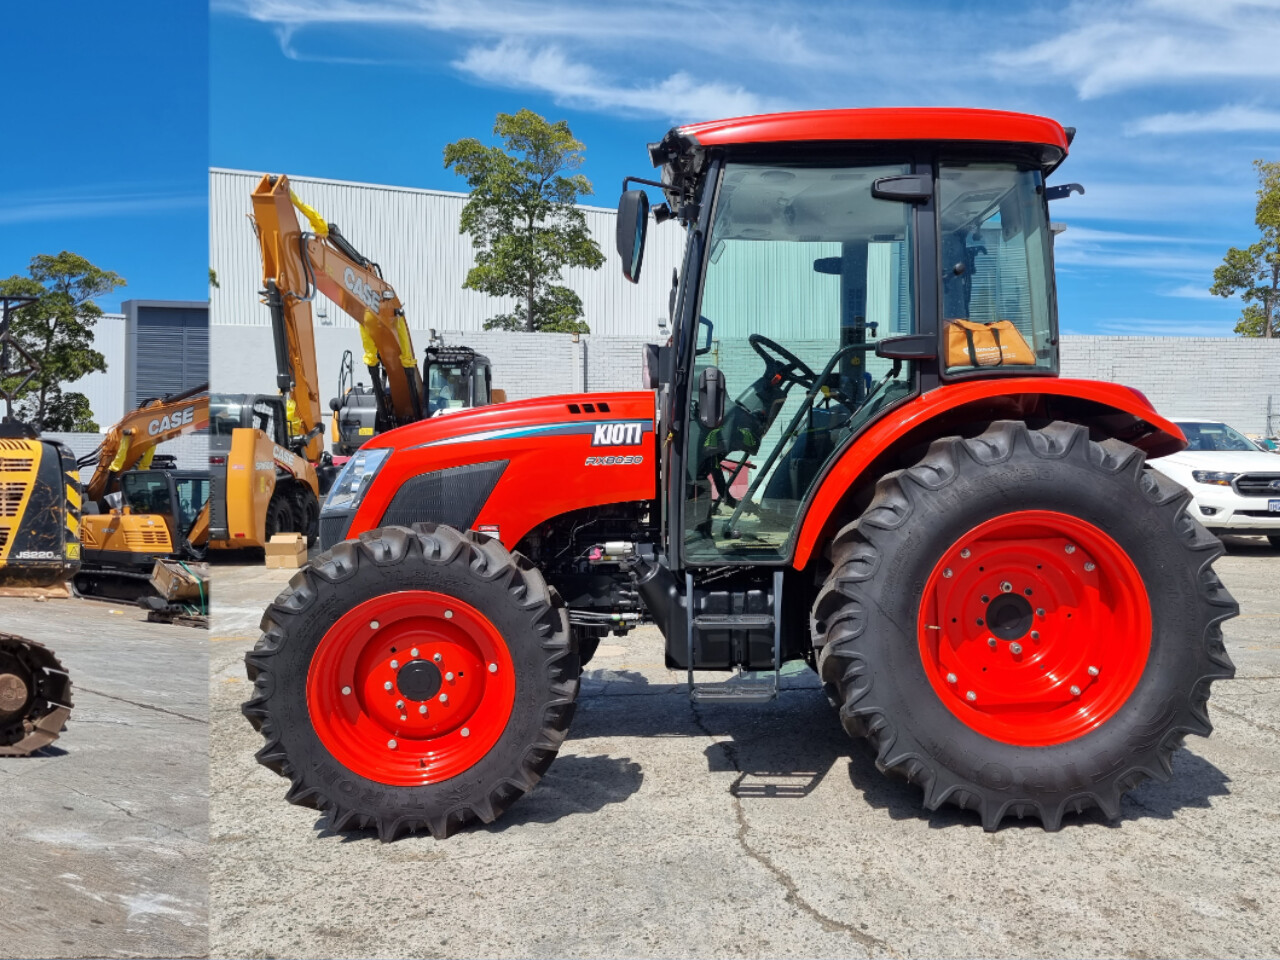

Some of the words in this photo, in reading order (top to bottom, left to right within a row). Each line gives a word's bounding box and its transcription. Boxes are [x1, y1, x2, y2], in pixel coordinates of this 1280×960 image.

[343, 266, 381, 315] CASE
[148, 406, 195, 436] CASE
[593, 423, 642, 445] KIOTI
[272, 445, 295, 466] CASE
[584, 455, 644, 466] RX8030
[16, 551, 54, 559] JS220
